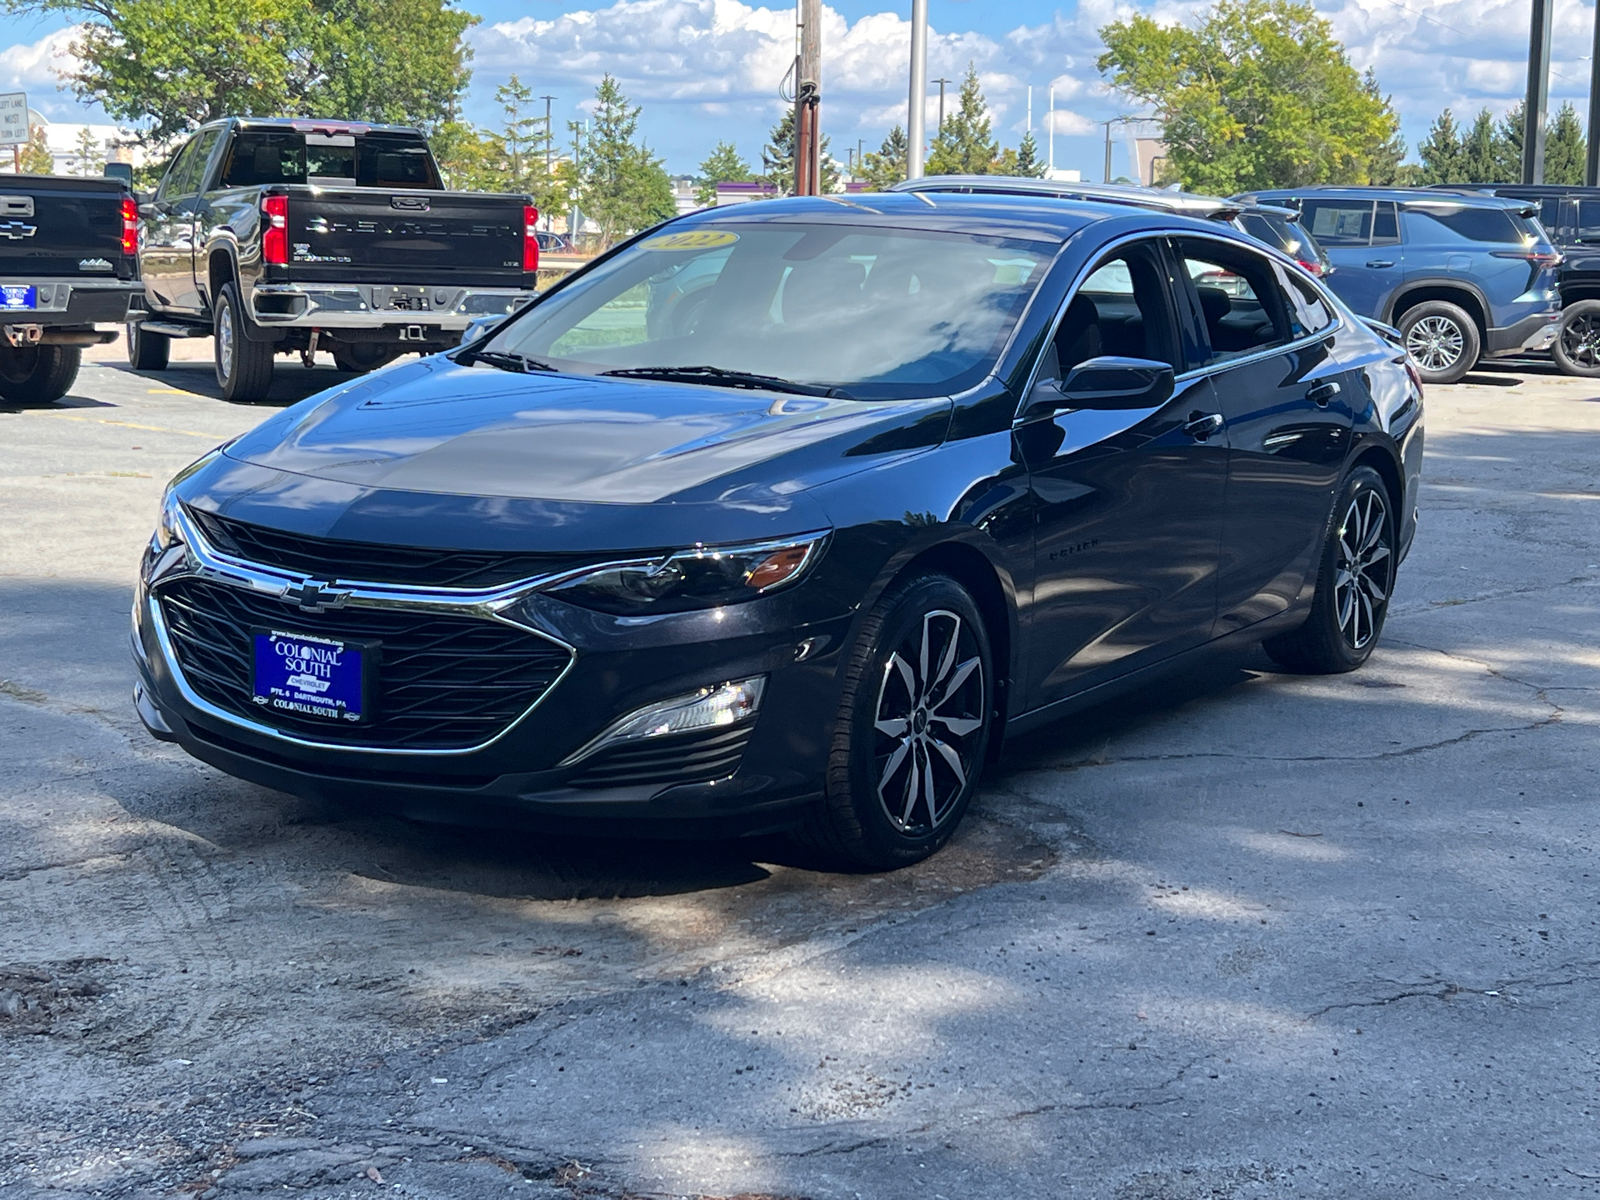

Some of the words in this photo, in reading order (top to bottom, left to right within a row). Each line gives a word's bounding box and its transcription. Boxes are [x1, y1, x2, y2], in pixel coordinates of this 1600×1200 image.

[11, 99, 23, 108] LANE
[5, 114, 19, 124] MUST
[1, 130, 13, 138] TURN
[14, 129, 25, 138] LEFT
[648, 234, 726, 247] 2022
[275, 641, 342, 666] COLONIAL
[285, 657, 331, 678] SOUTH
[290, 677, 326, 690] CHEVROLET
[273, 698, 311, 714] COLONIAL
[312, 705, 338, 718] SOUTH
